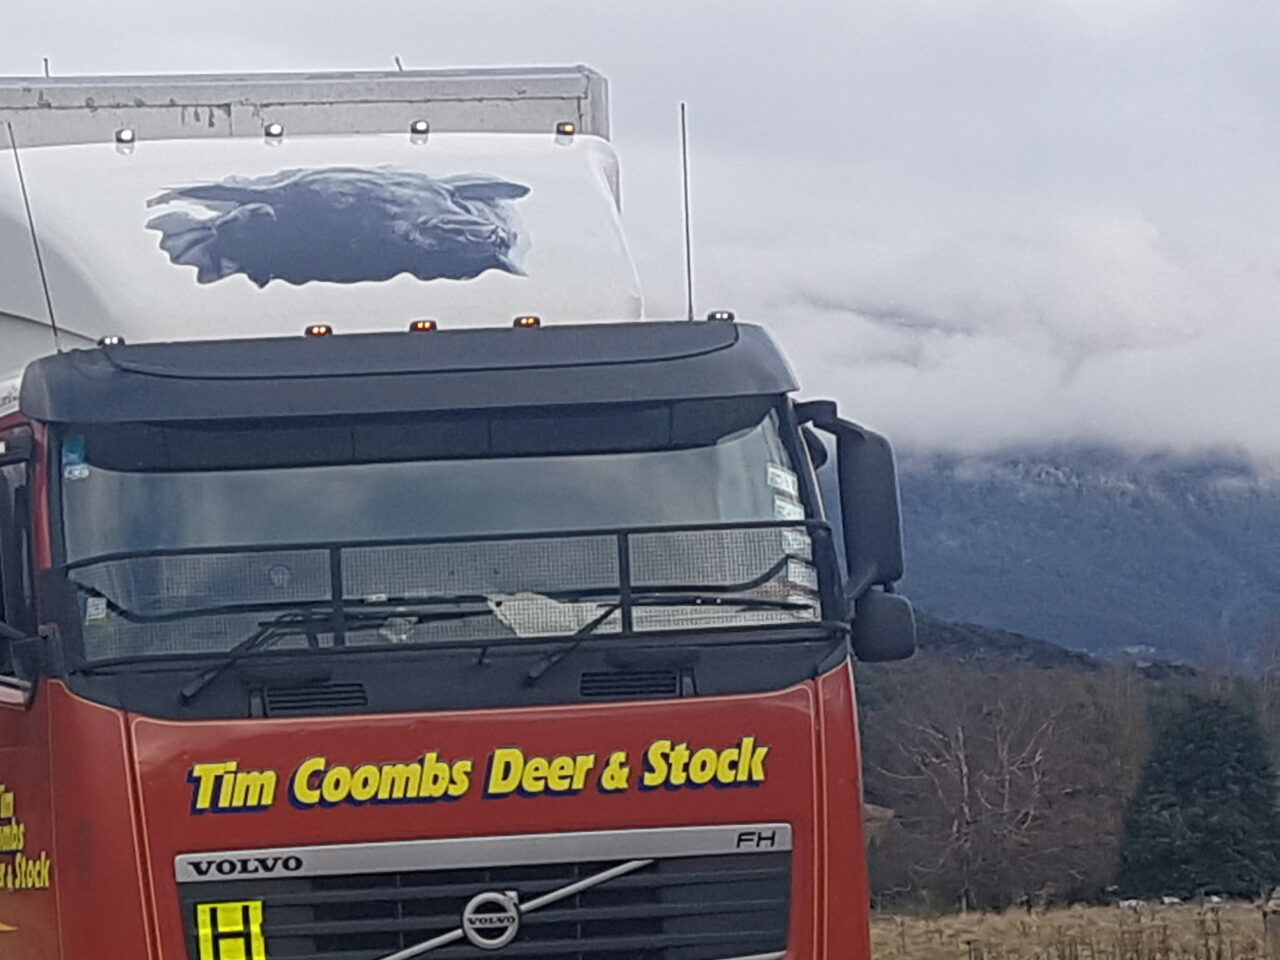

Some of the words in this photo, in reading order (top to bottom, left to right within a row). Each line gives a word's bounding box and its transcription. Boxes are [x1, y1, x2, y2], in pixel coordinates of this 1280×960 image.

[192, 761, 278, 811] Tim
[291, 751, 473, 804] Coombs
[488, 747, 596, 795] Deer
[601, 750, 630, 791] &
[642, 736, 770, 787] Stock
[736, 830, 777, 849] FH
[15, 850, 52, 889] Stock
[187, 855, 303, 877] VOLVO
[467, 915, 516, 926] VOLVO
